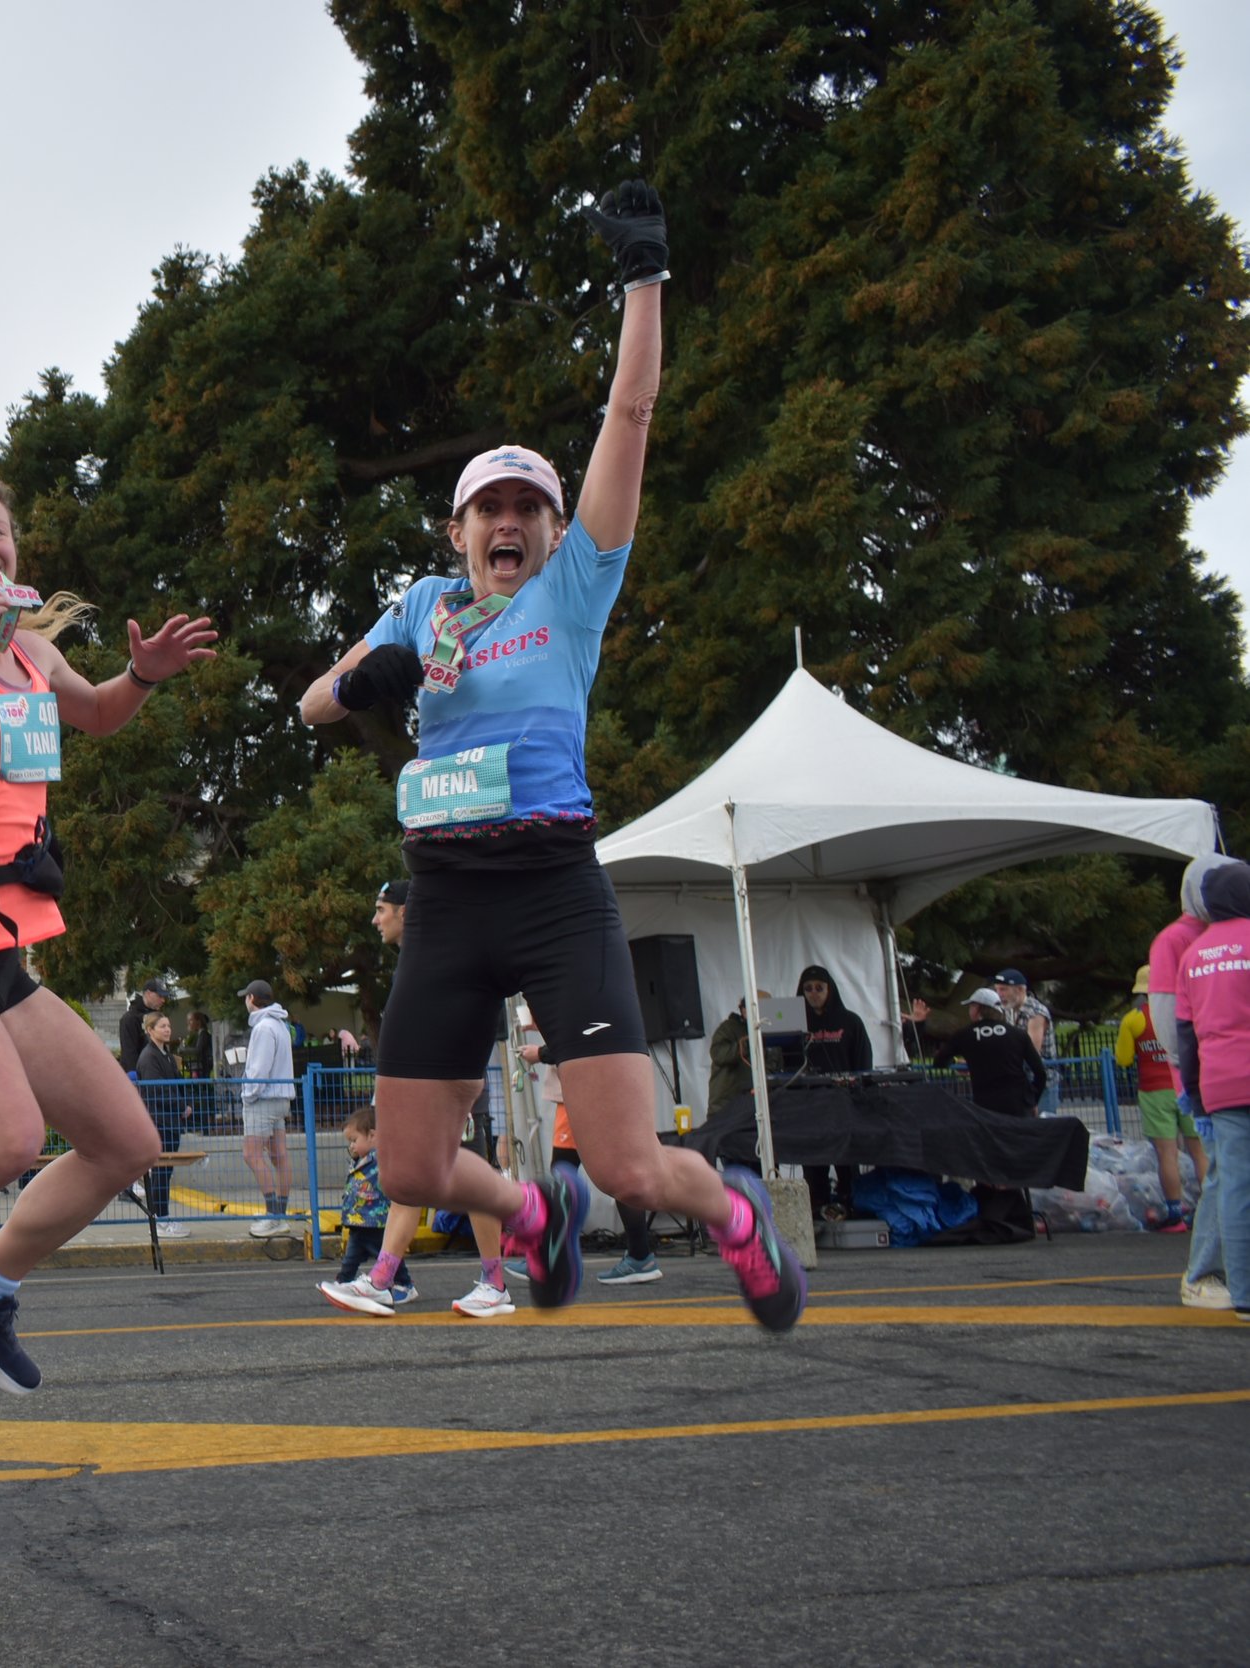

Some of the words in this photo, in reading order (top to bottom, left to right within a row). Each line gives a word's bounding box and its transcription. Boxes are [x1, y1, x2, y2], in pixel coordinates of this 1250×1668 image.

[5, 588, 40, 600] 10K
[464, 626, 550, 670] isters
[504, 652, 548, 668] Victoria
[7, 708, 24, 718] 10K
[23, 731, 58, 755] YANA
[422, 770, 478, 799] MENA
[973, 1024, 1007, 1041] 100
